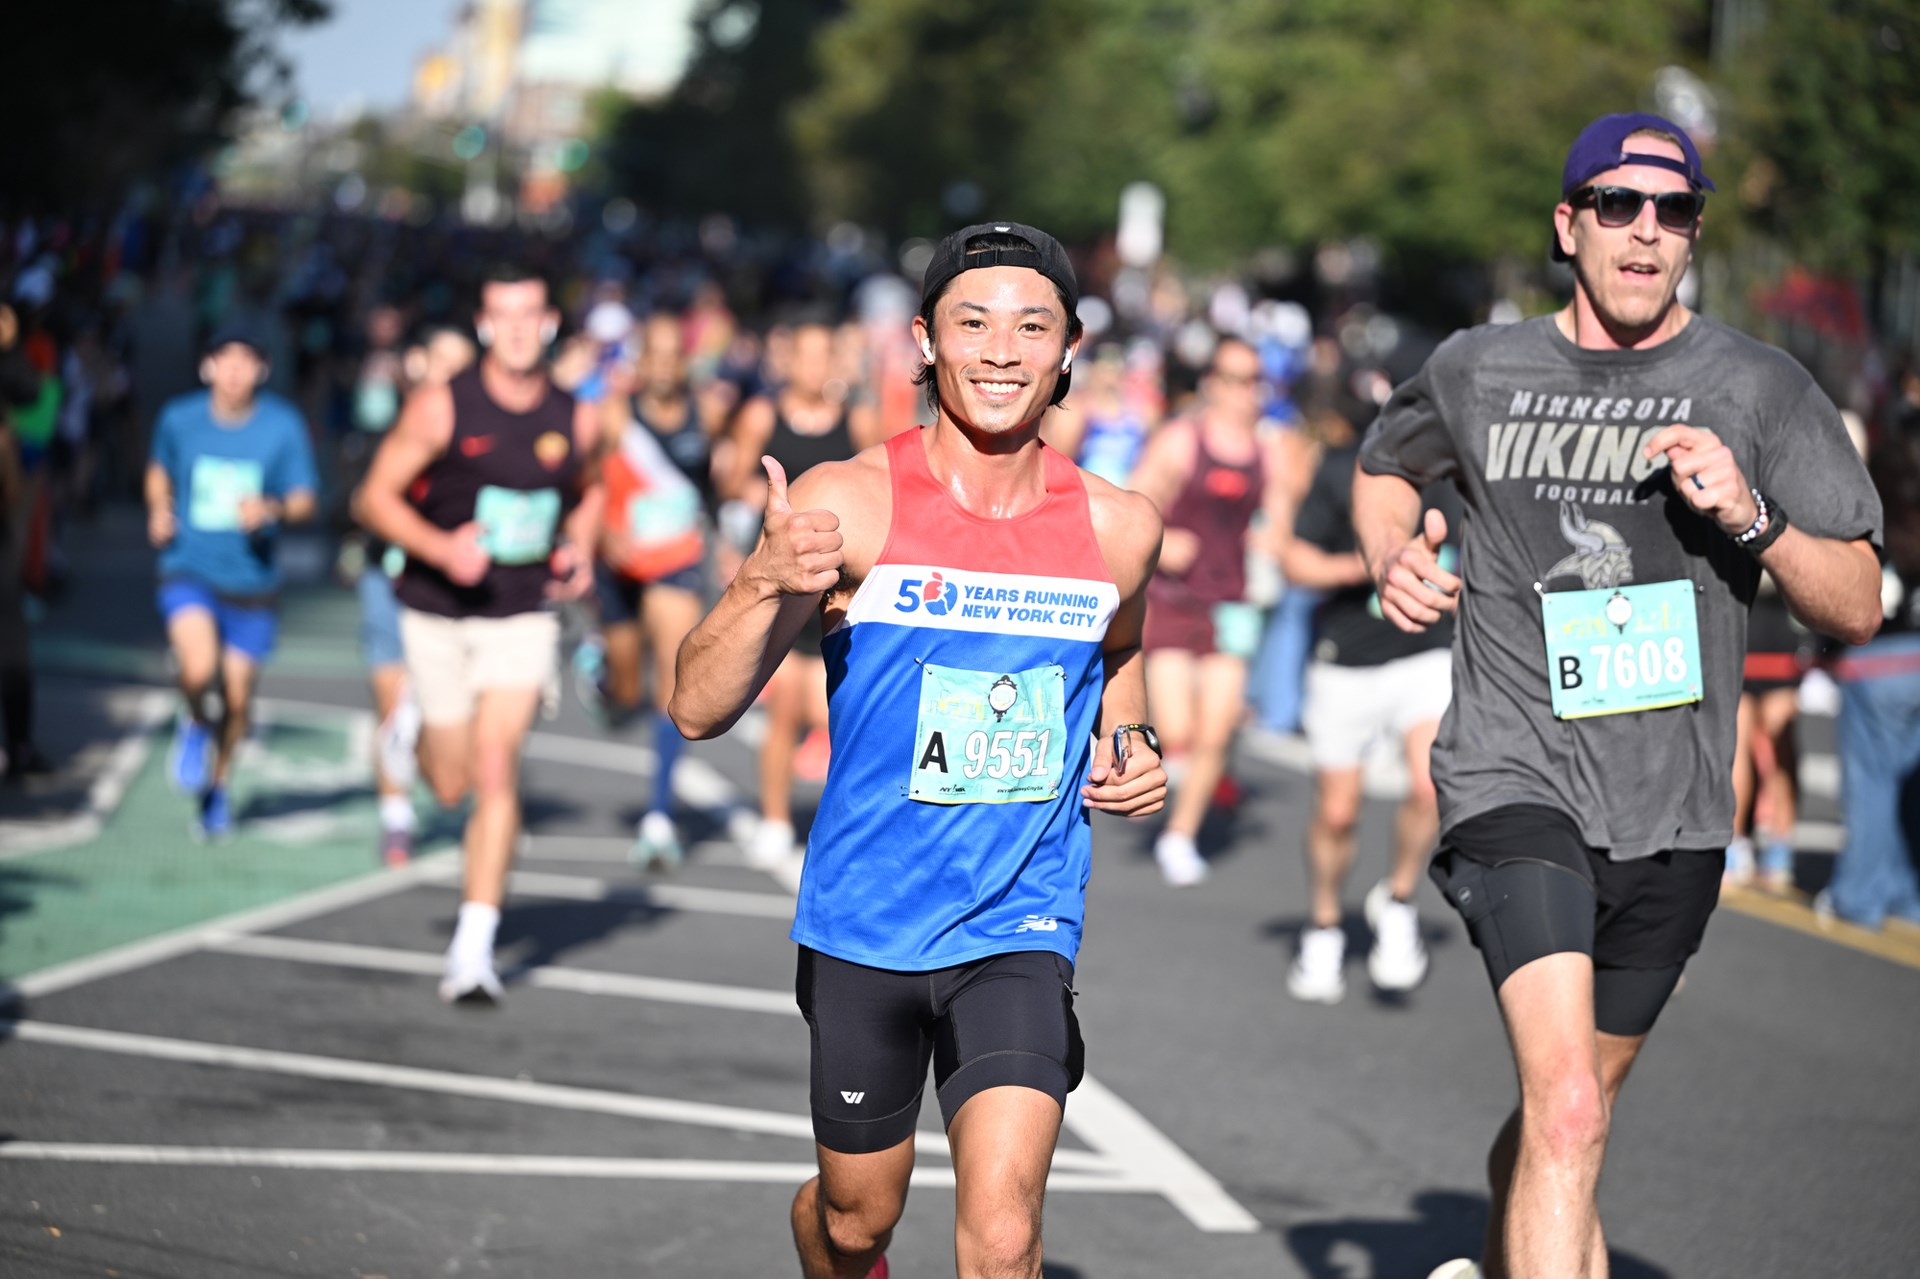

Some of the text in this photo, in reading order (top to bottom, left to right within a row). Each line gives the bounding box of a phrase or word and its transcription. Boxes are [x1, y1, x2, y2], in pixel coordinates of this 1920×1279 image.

[1509, 390, 1692, 421] MINNESOTA
[1485, 422, 1711, 482] VIKING
[1535, 484, 1648, 505] FOOTBAL
[964, 585, 1098, 609] YEARS RUNNING
[961, 604, 1097, 627] NEW YORK CITY
[1559, 636, 1687, 691] B 7608
[918, 731, 948, 773] A
[963, 729, 1051, 779] 9551
